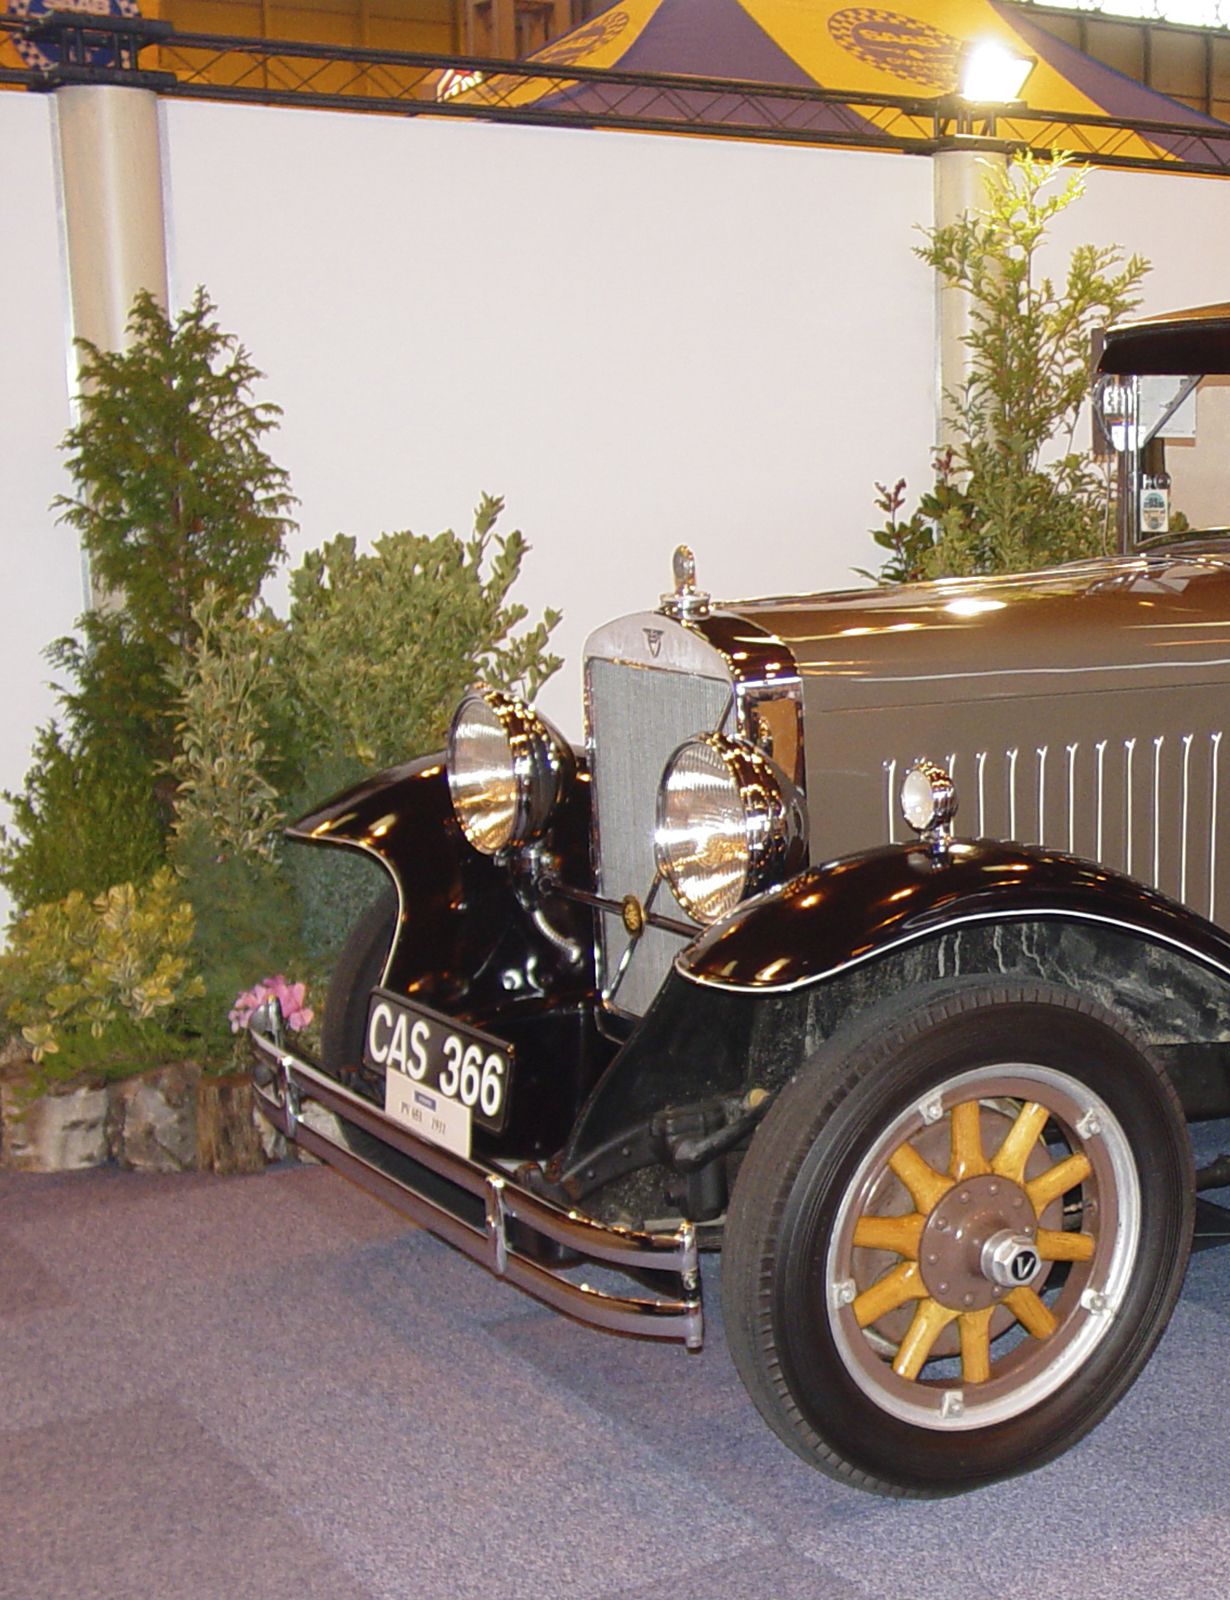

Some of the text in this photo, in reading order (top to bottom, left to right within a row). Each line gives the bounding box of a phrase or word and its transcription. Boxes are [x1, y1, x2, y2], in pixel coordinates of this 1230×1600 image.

[369, 1003, 504, 1117] CAS 366
[1016, 1256, 1035, 1278] V
